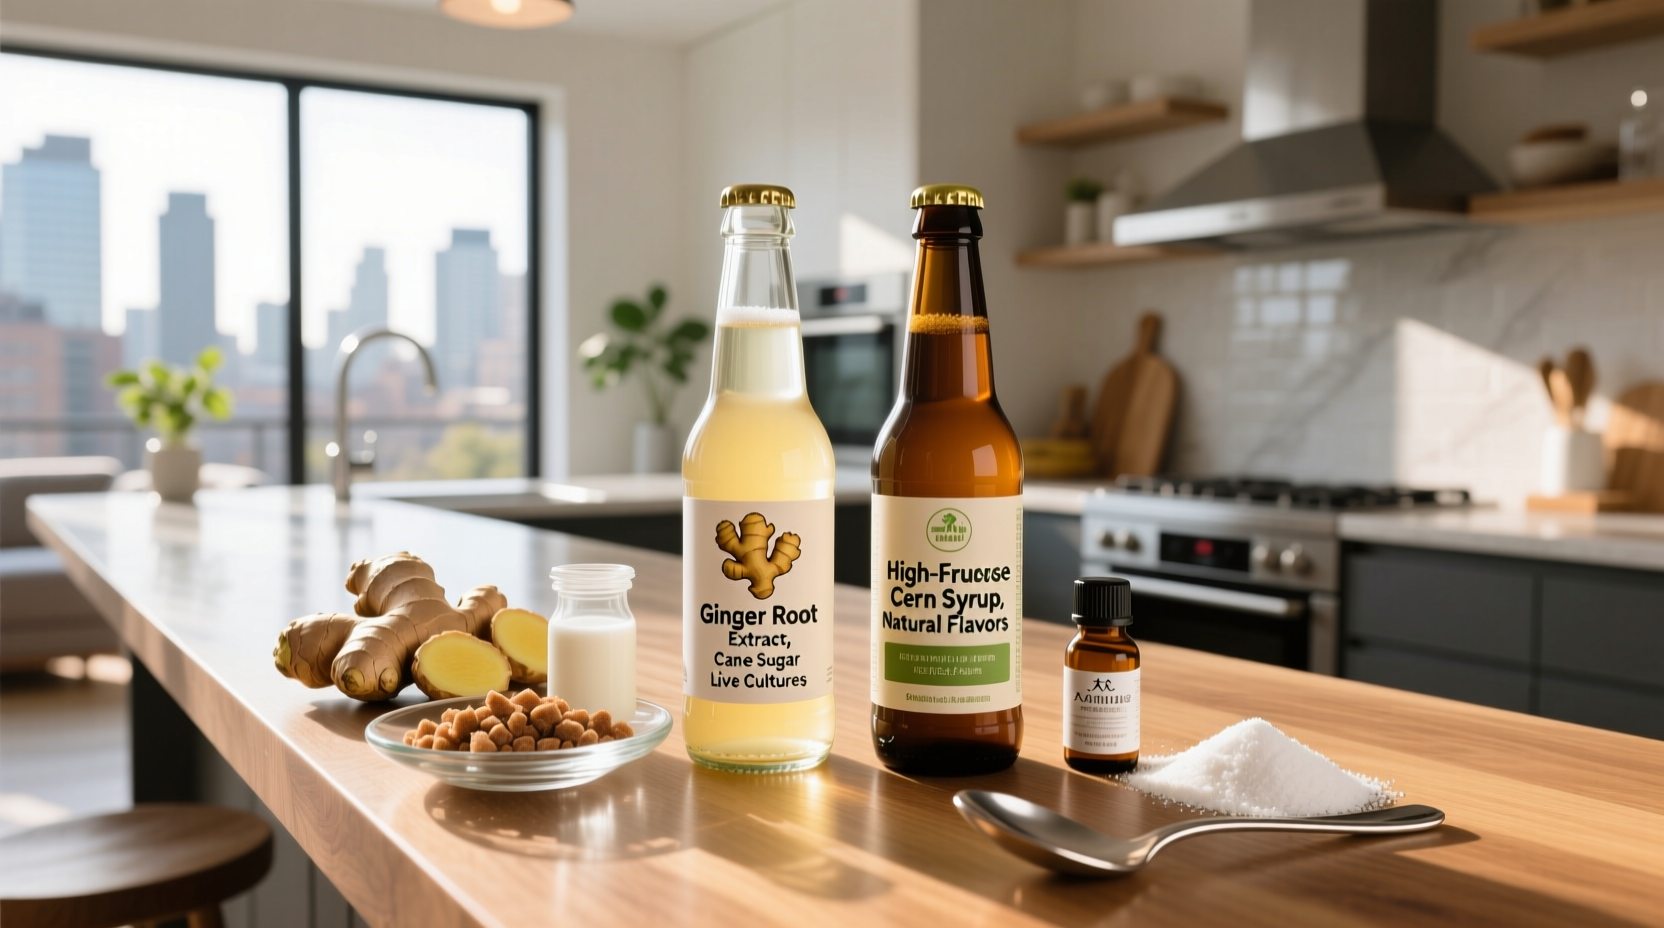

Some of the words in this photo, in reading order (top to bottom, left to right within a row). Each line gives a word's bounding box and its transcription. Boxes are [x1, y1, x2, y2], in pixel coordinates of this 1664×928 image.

[942, 588, 1004, 615] Syrup,
[700, 603, 767, 631] Ginger
[772, 604, 818, 625] Root
[882, 611, 942, 633] Natural
[947, 614, 1009, 634] Flavors
[728, 631, 791, 649] Extract,
[714, 651, 753, 667] Cane
[757, 653, 800, 671] Sugar
[711, 671, 740, 687] Live
[744, 673, 807, 688] Cultures
